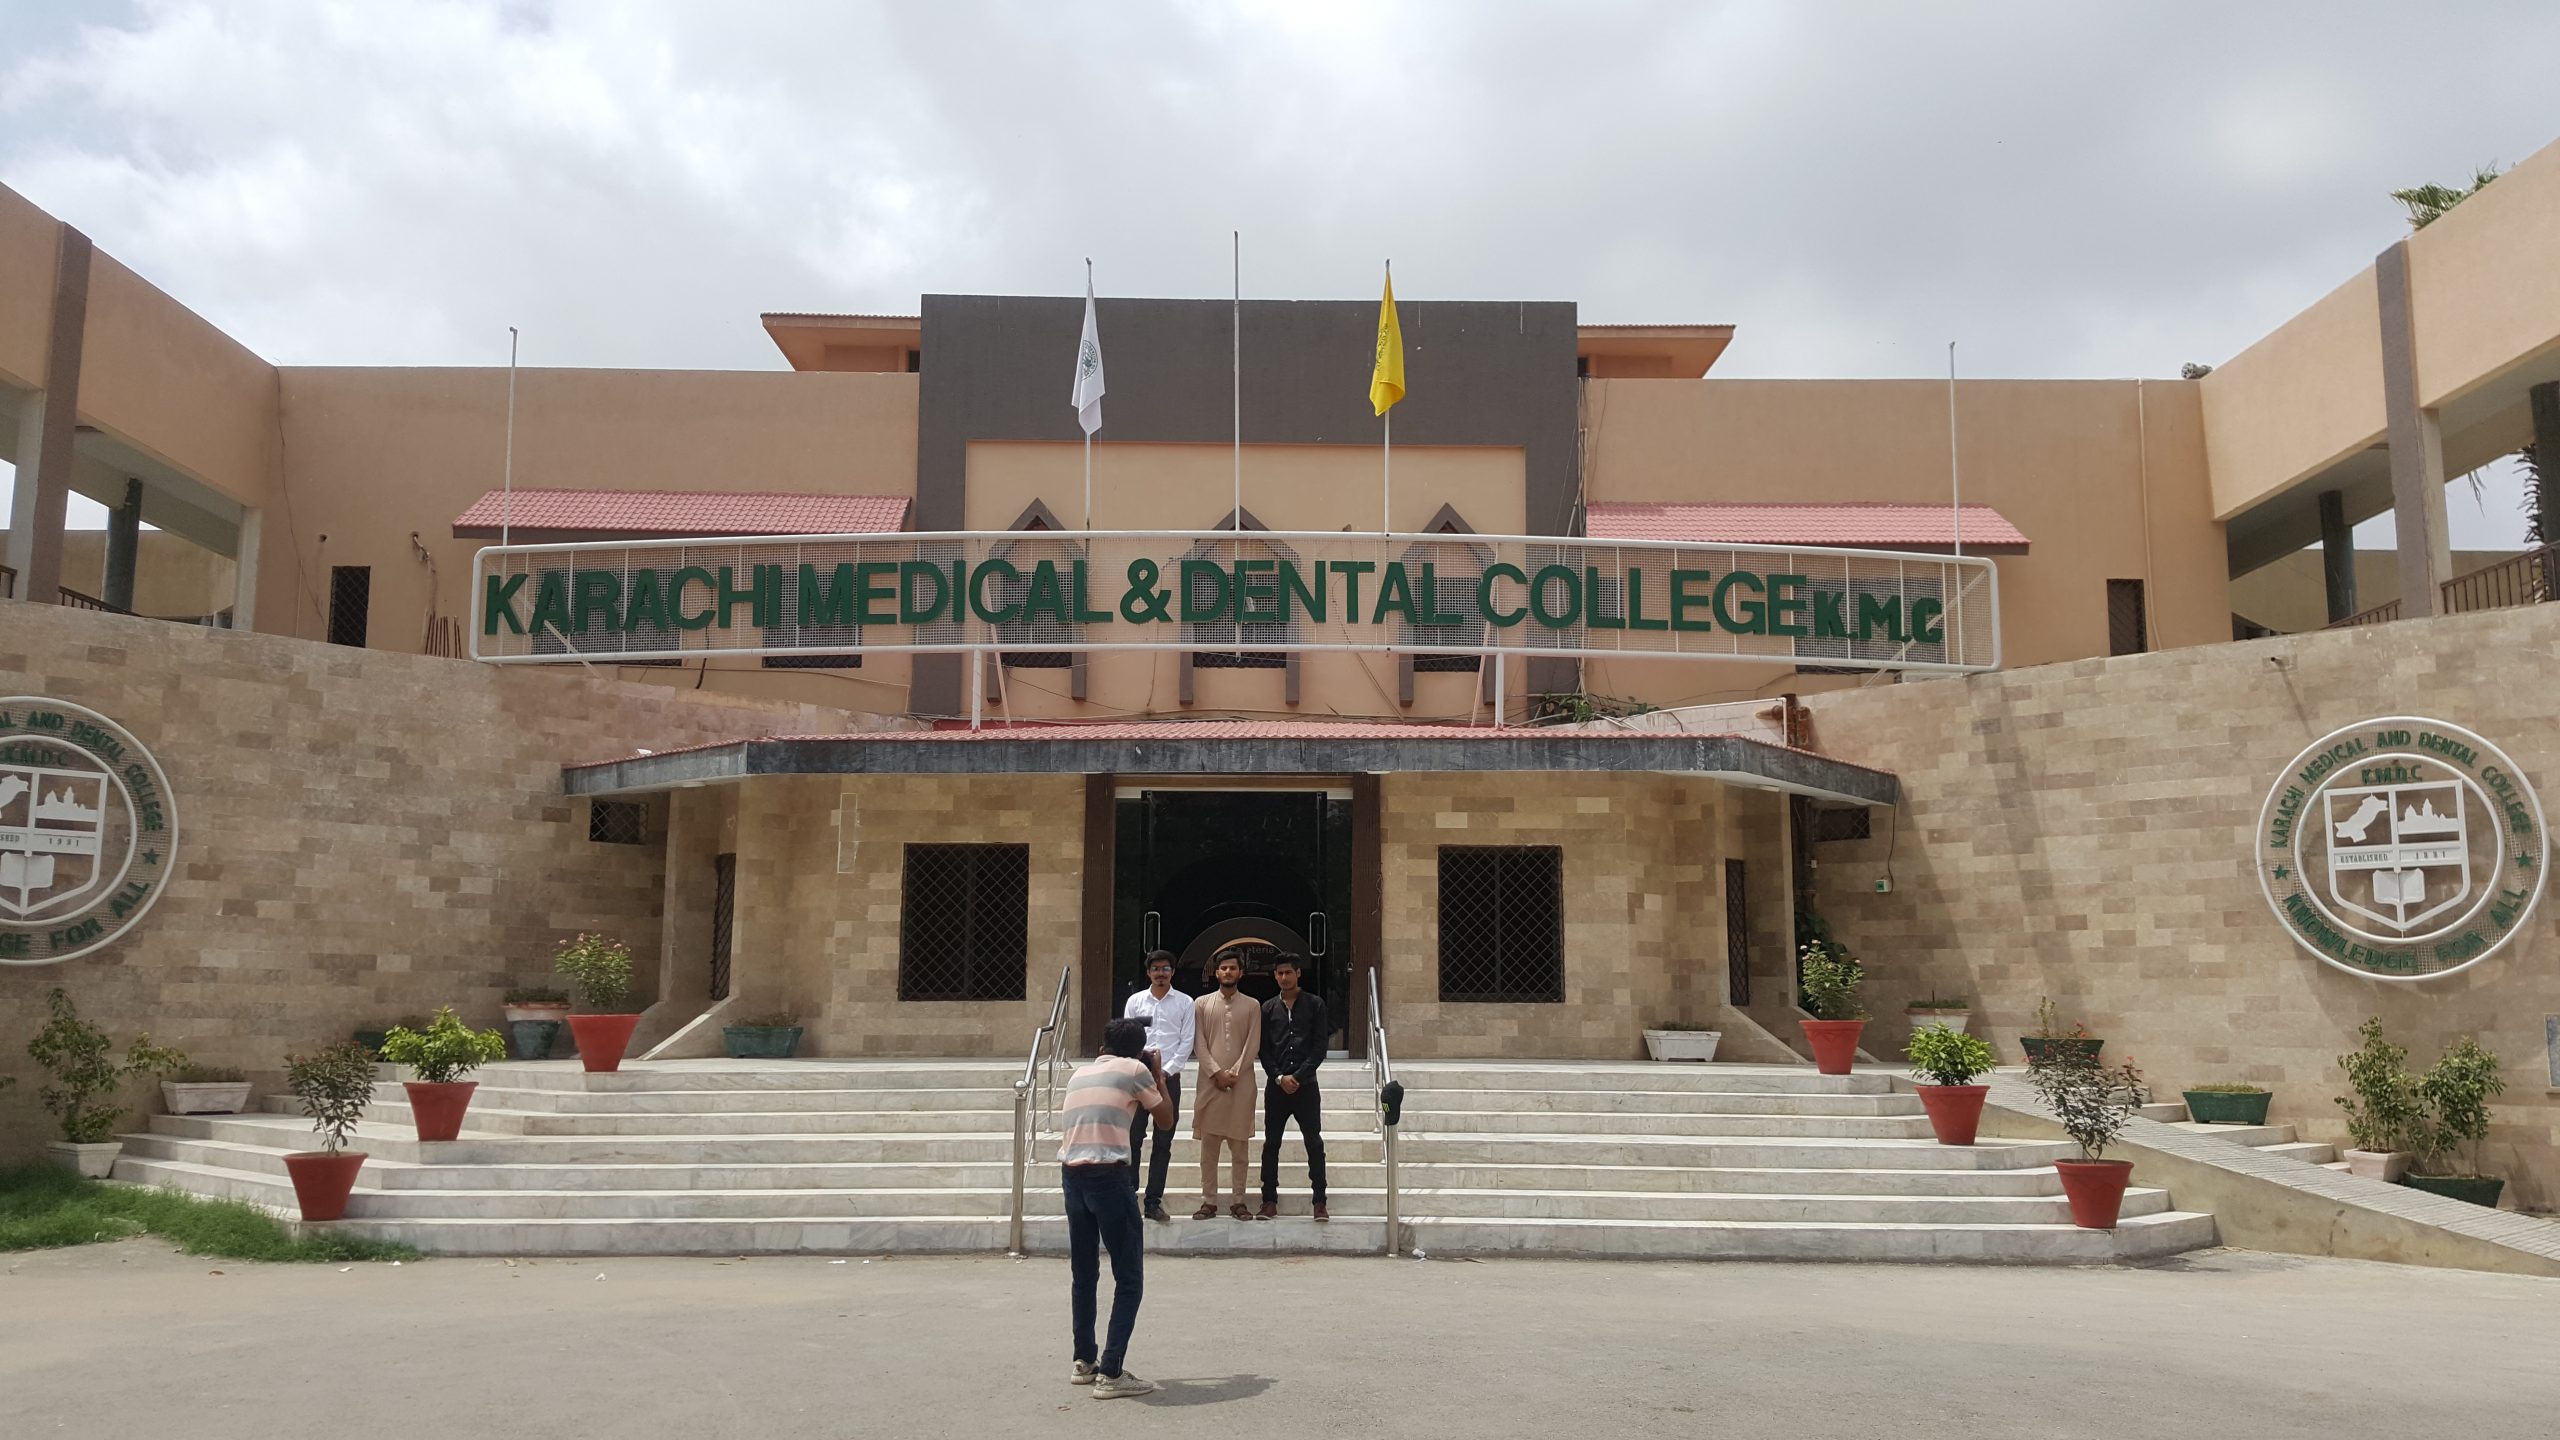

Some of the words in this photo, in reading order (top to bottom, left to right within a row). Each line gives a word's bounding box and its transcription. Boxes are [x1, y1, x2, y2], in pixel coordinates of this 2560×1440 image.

[485, 566, 781, 635] KARACHI
[798, 560, 1113, 625] MEDICAL
[1120, 559, 1171, 623] &
[1181, 560, 1463, 625] DENTAL
[1478, 563, 1808, 636] COLLEGE
[27, 711, 64, 730] AND
[71, 720, 126, 763] DENTAL
[125, 764, 163, 831] COLLEGE
[2270, 785, 2305, 848] KARACHI
[2299, 738, 2368, 784] MEDICAL
[2376, 730, 2411, 748] AND
[2418, 732, 2480, 768] DENTAL
[2481, 766, 2532, 832] COLLEGE
[49, 918, 103, 950] FOR
[110, 881, 149, 919] ALL
[2283, 894, 2417, 970] KNOWLEDGE
[2435, 930, 2487, 961] FOR
[2490, 888, 2528, 928] ALL
